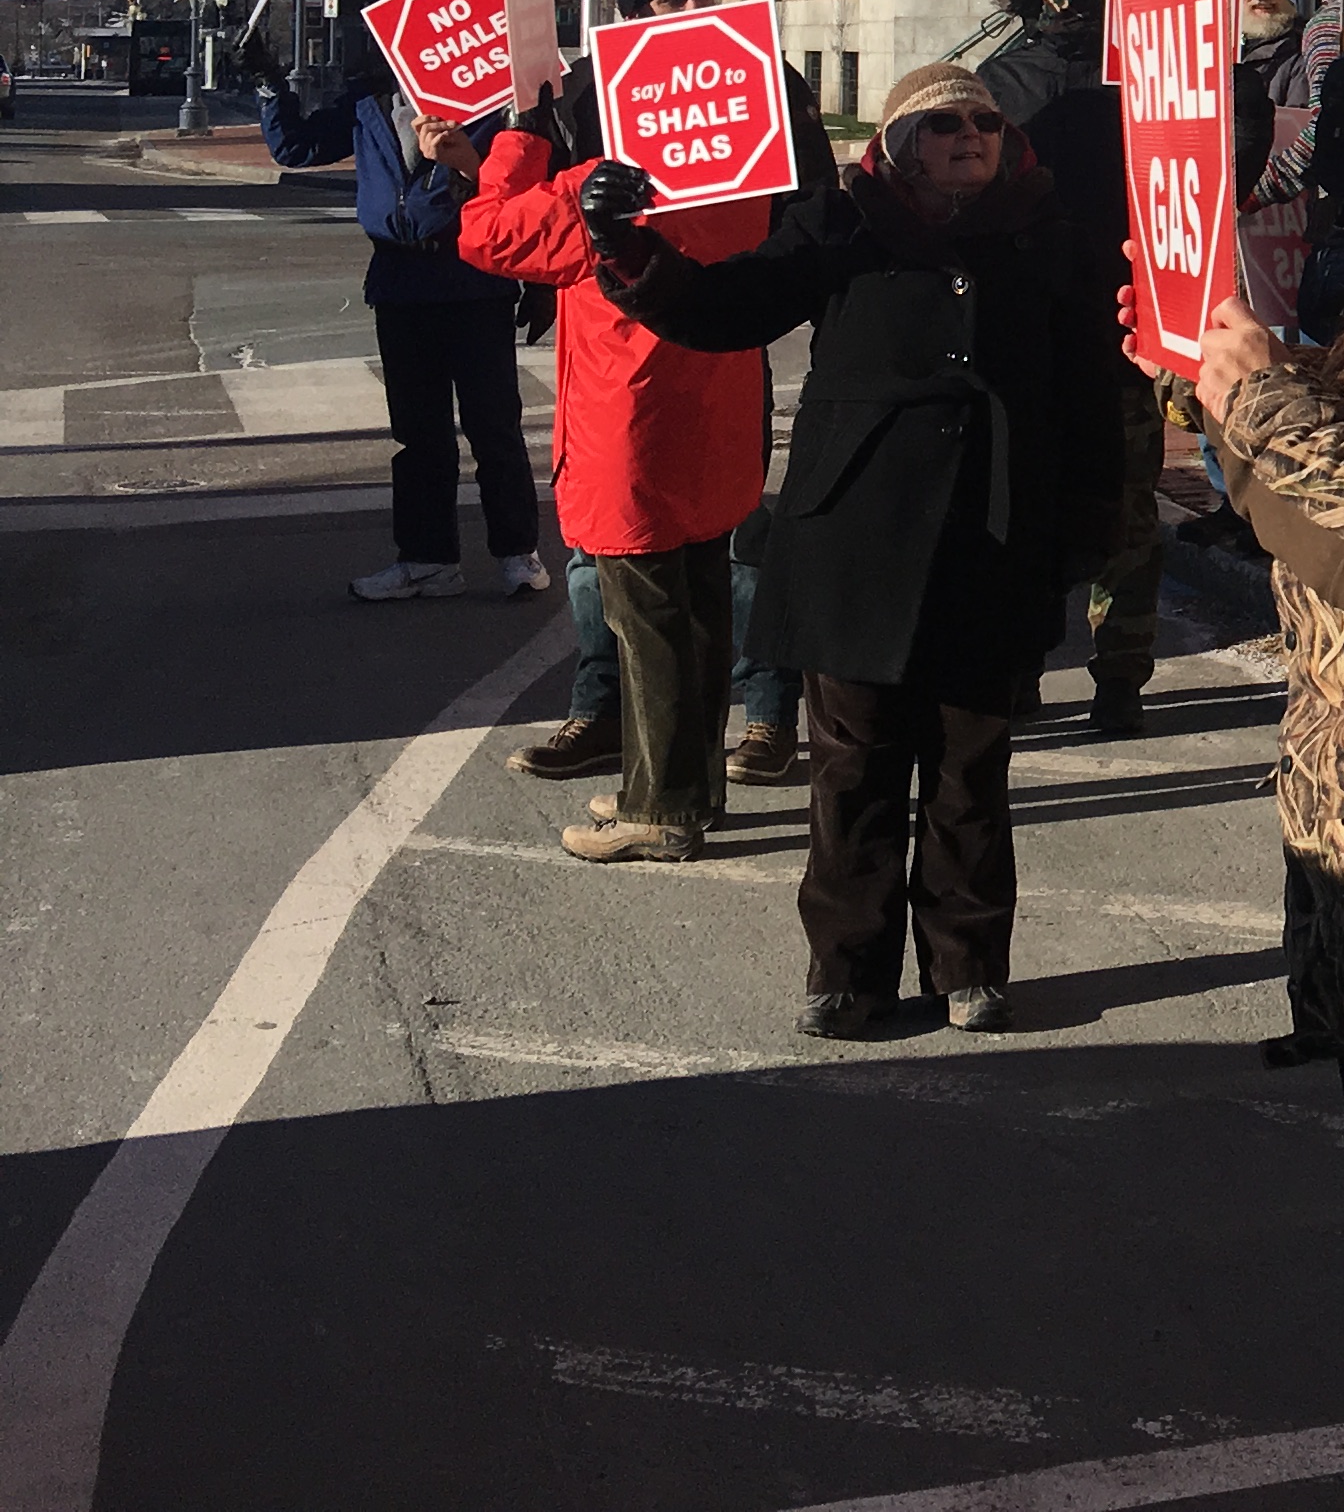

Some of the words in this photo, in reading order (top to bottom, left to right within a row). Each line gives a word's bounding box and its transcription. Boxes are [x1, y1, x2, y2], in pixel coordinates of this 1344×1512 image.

[427, 0, 471, 33] NO
[419, 10, 509, 71] SHALE
[451, 47, 511, 89] GAS
[631, 82, 665, 103] say
[671, 60, 720, 95] NO
[725, 68, 746, 86] to
[637, 96, 750, 138] SHALE
[662, 134, 732, 168] GAS
[1149, 157, 1203, 278] GAS
